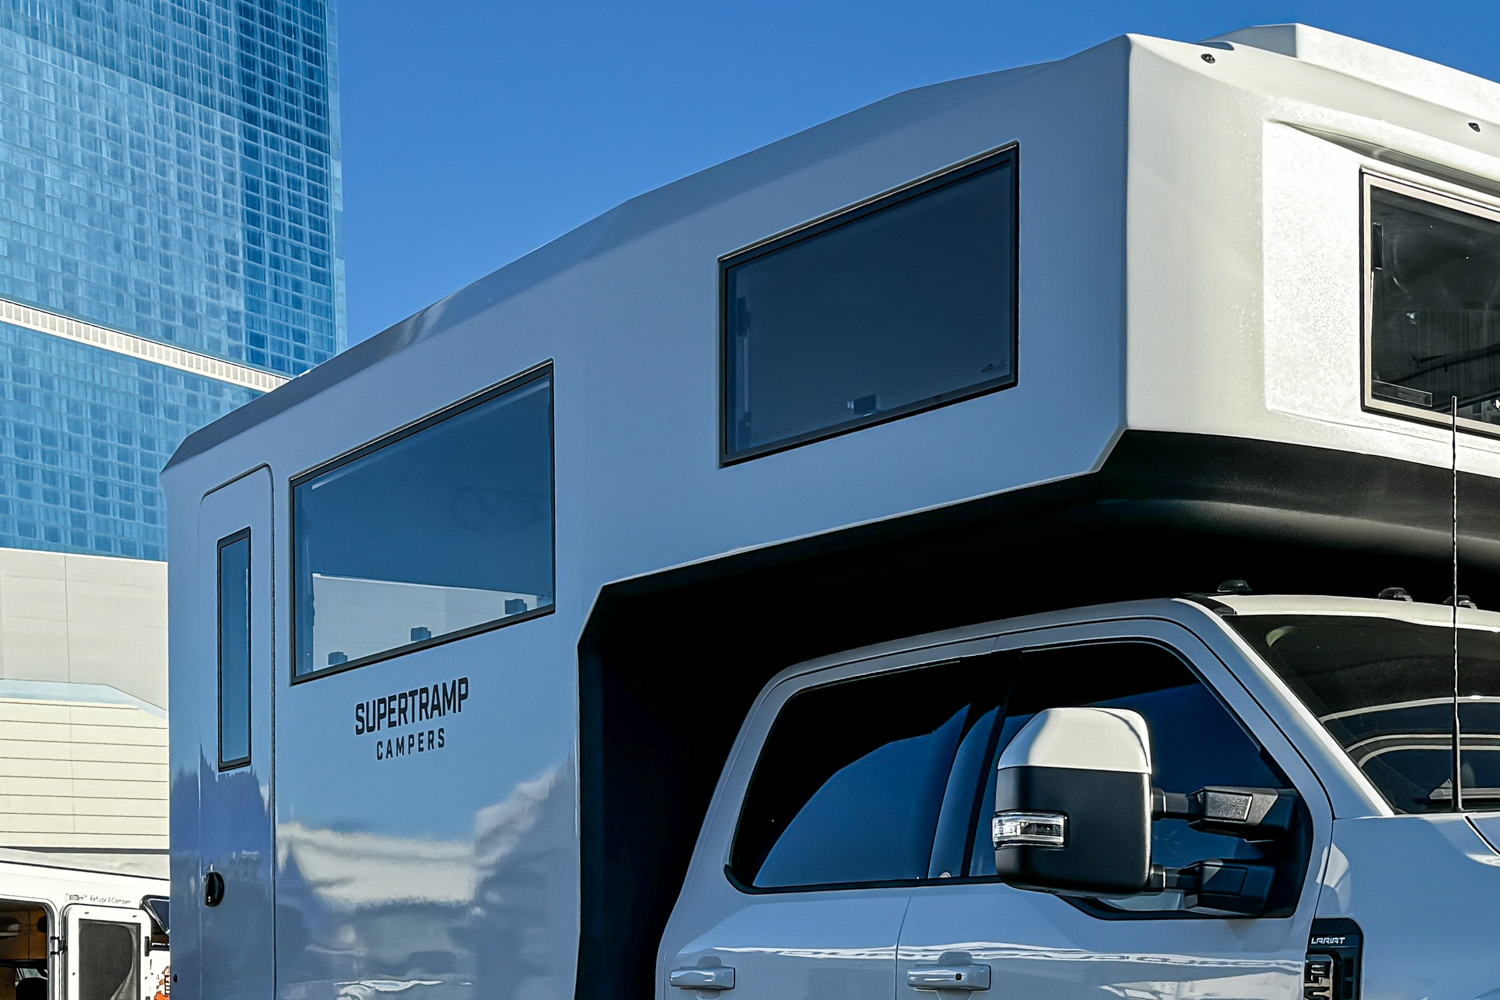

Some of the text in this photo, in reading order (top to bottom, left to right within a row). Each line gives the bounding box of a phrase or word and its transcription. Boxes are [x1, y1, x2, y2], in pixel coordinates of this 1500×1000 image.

[355, 676, 469, 735] SUPERTRAMP
[376, 727, 445, 761] CAMPERS
[1311, 936, 1346, 945] LARIAT
